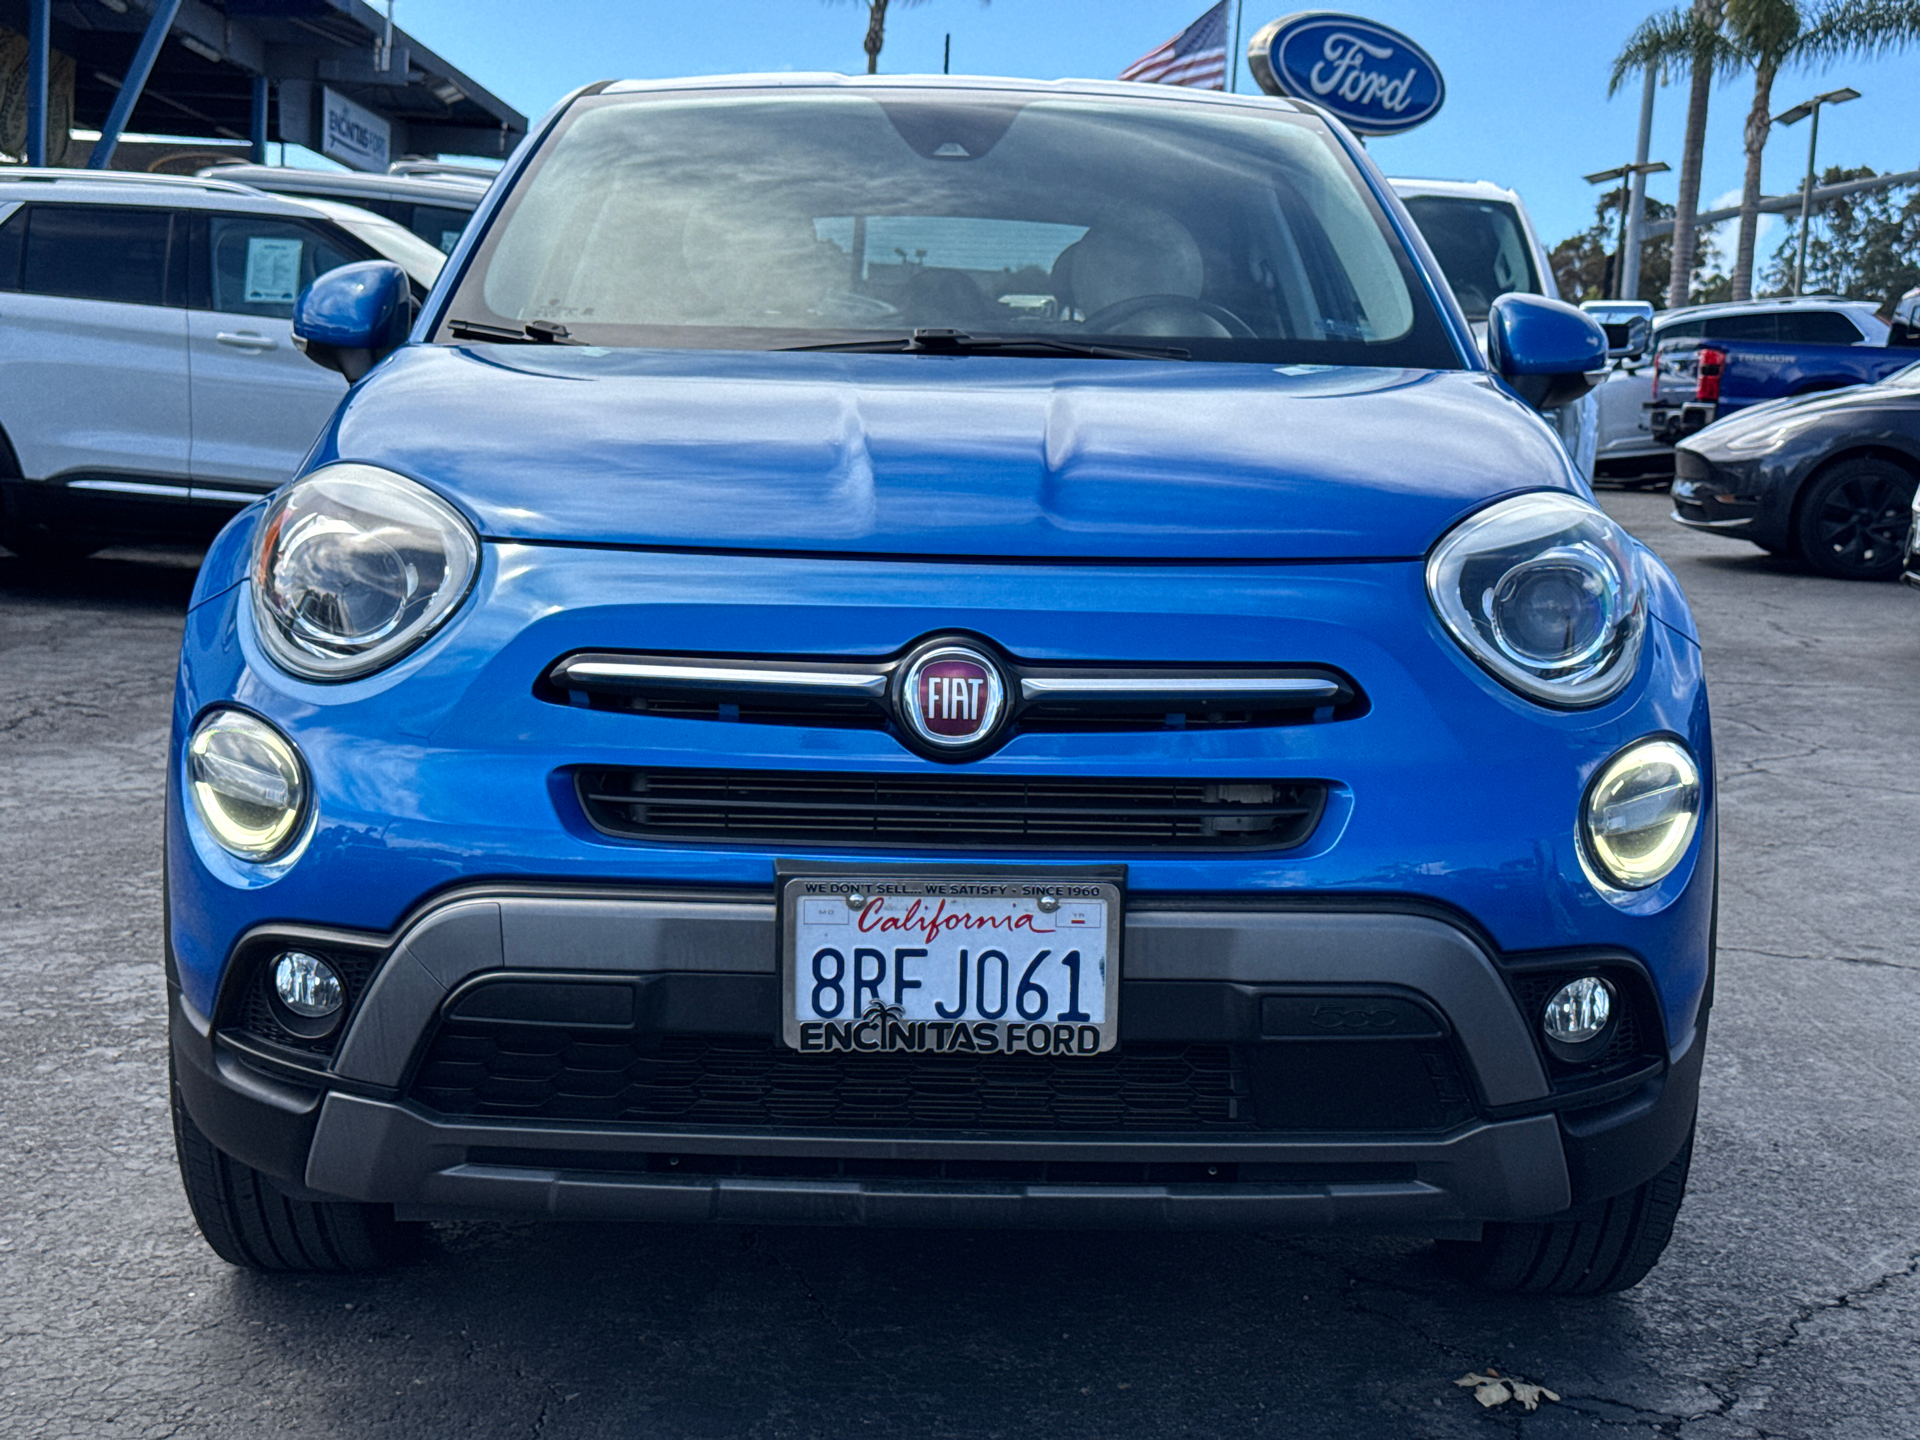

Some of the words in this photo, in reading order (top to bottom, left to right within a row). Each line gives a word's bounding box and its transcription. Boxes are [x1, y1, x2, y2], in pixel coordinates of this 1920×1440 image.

[1310, 32, 1417, 112] Ford
[1738, 353, 1797, 363] TREMOR
[928, 677, 984, 720] FIAT
[805, 883, 827, 893] WE
[831, 883, 873, 893] DON'T
[876, 883, 922, 894] SELL...
[925, 884, 947, 895] WE
[951, 885, 1008, 895] SATISFY
[1022, 886, 1064, 896] SINCE
[1067, 887, 1100, 897] 1960
[858, 897, 1056, 944] California
[811, 947, 1091, 1022] 8RFJ061
[1312, 1005, 1397, 1028] 500
[799, 1021, 999, 1052] ENCINITAS
[1006, 1022, 1101, 1055] FORD
